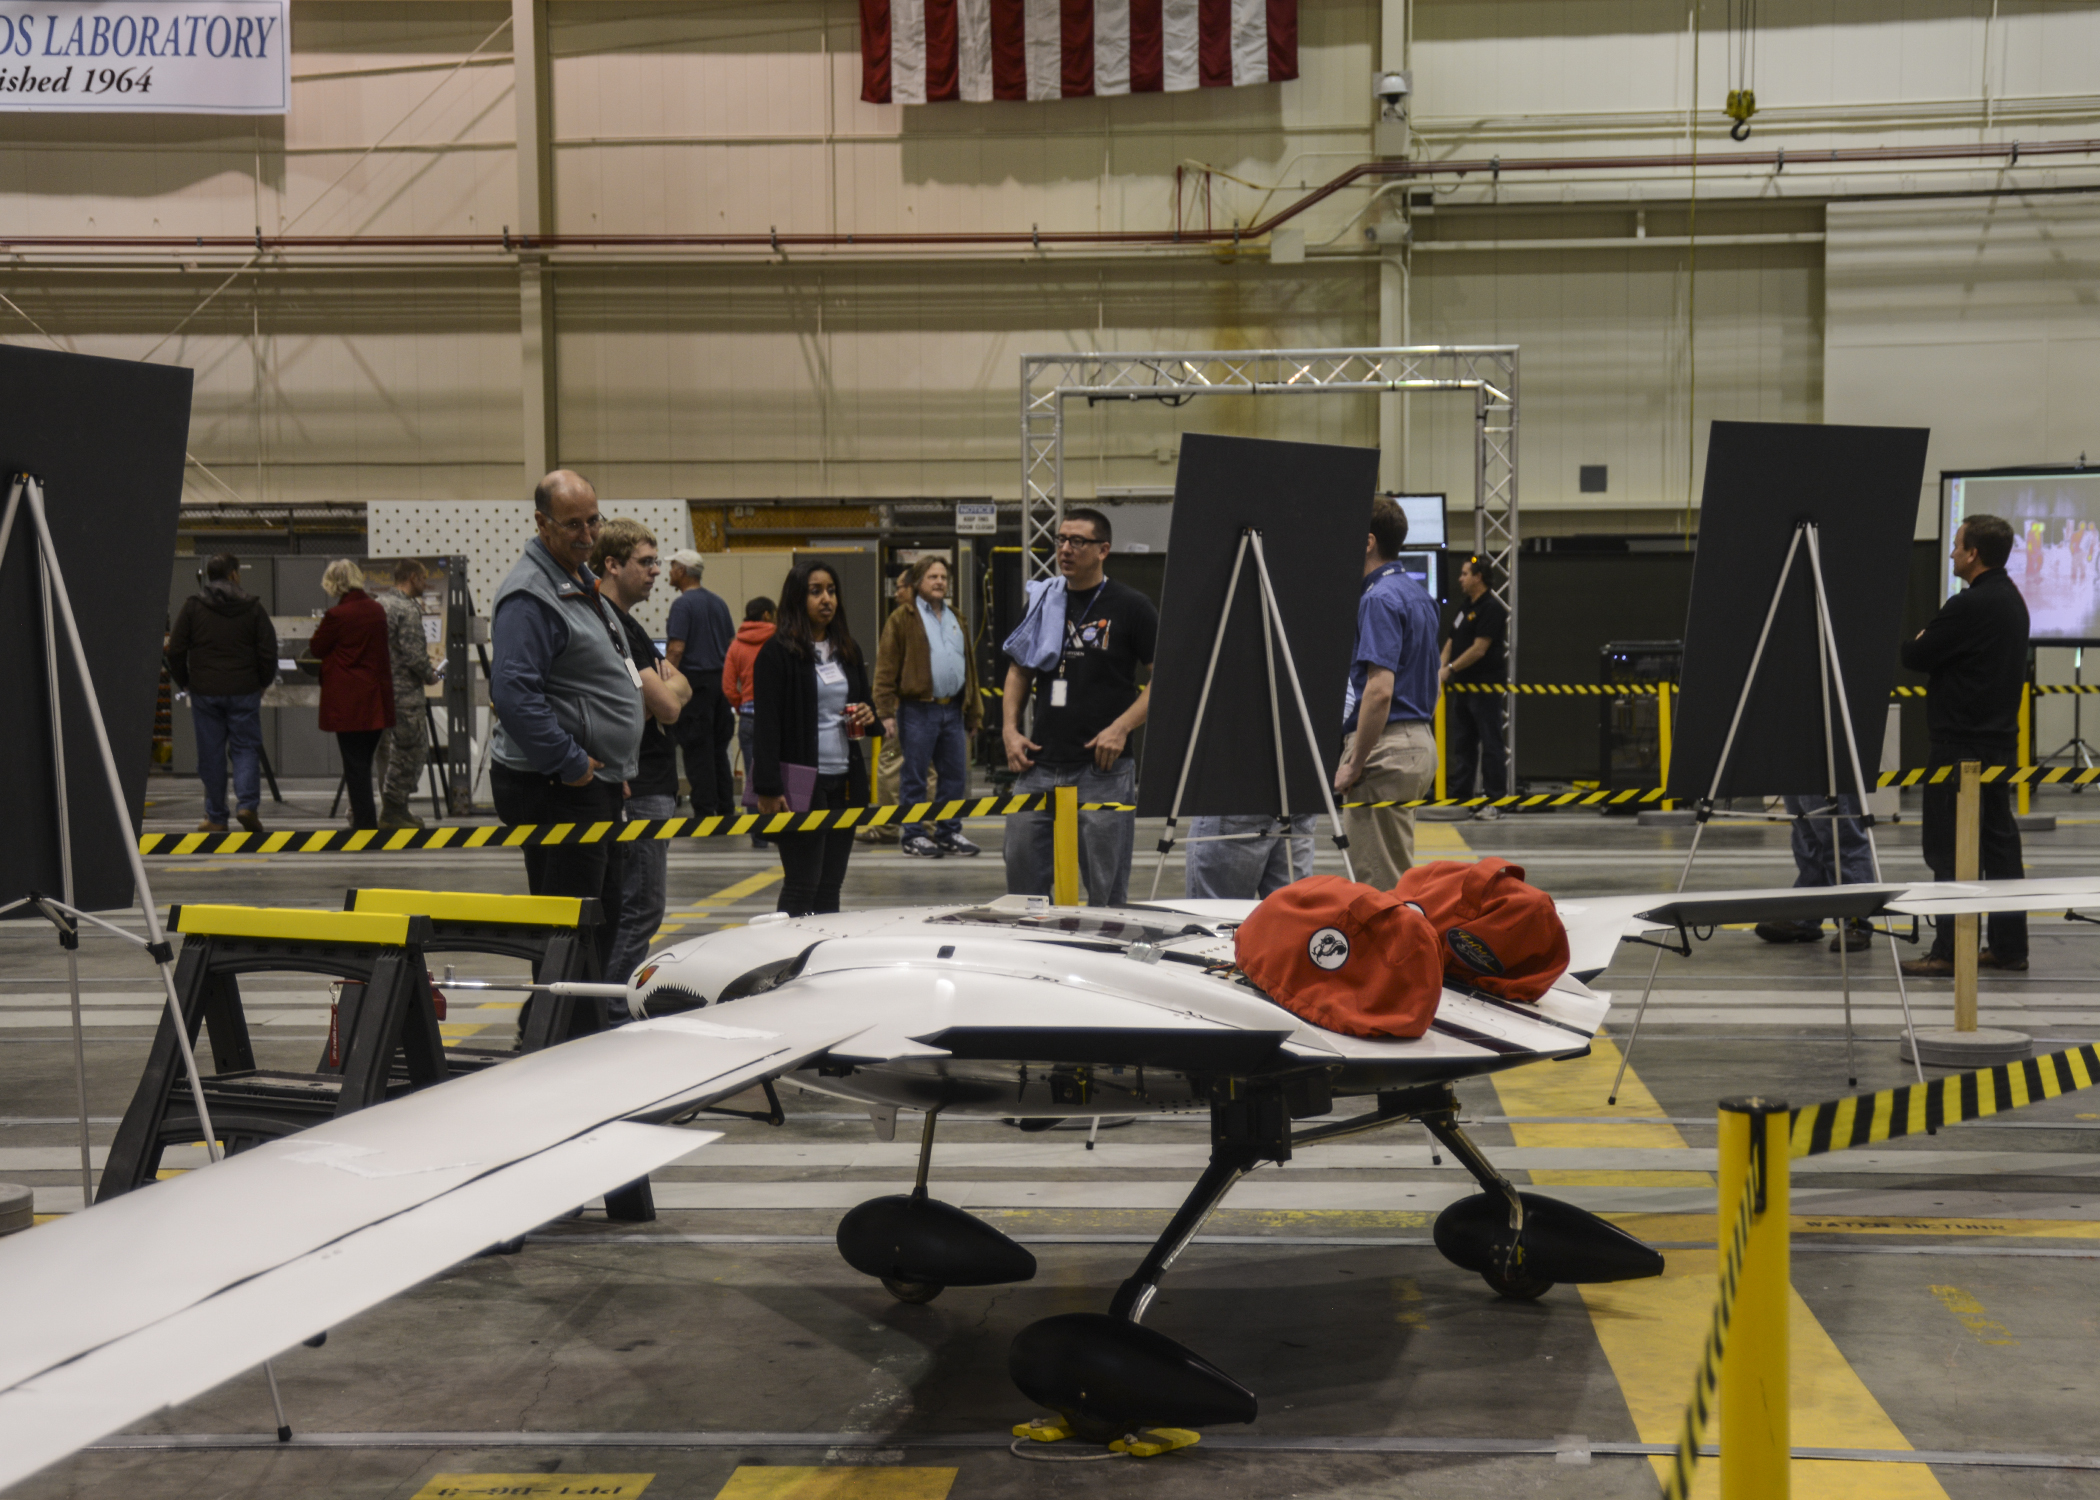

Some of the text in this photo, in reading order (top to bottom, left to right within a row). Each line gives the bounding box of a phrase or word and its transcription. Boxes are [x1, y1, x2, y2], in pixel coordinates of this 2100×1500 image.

[41, 15, 277, 58] LABORATORY
[0, 65, 154, 94] ished 1964
[960, 505, 992, 514] NOTICE
